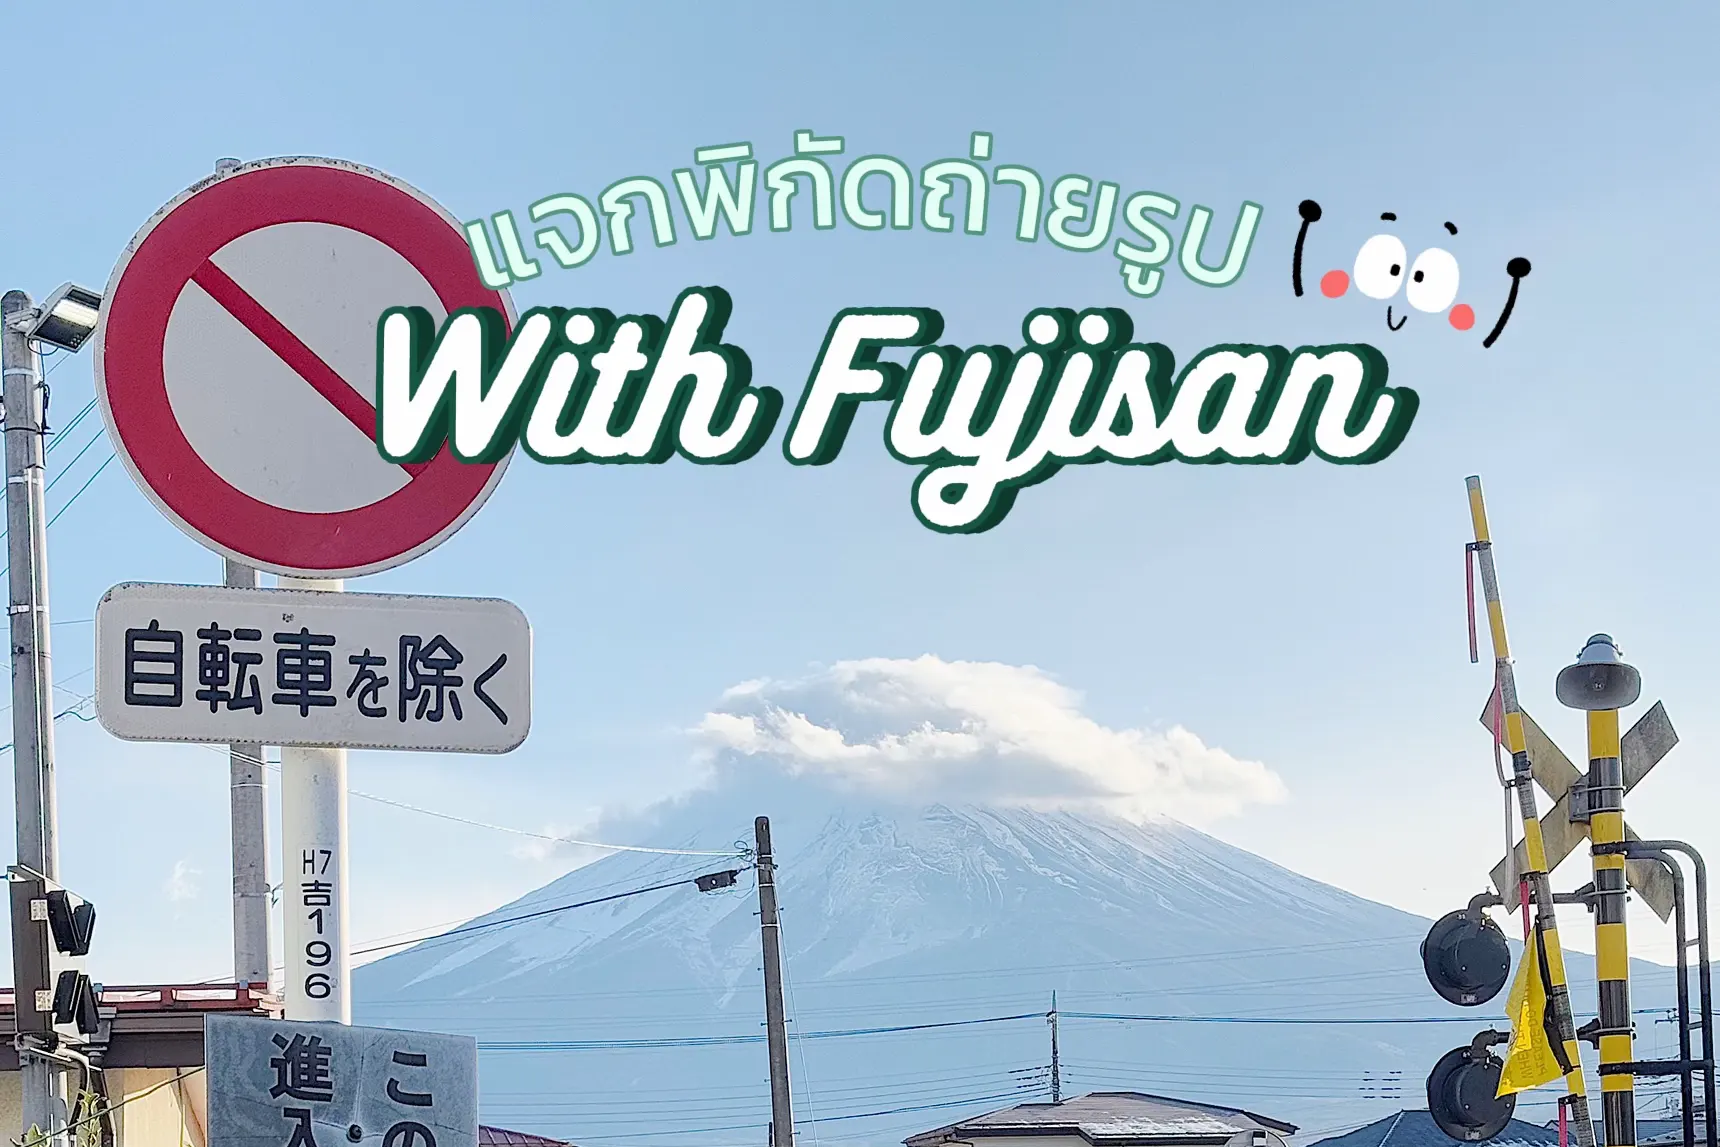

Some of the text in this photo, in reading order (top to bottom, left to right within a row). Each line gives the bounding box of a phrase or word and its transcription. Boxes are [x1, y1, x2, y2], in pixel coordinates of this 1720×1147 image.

[124, 619, 510, 726] 自転車を除く
[302, 848, 333, 875] H7
